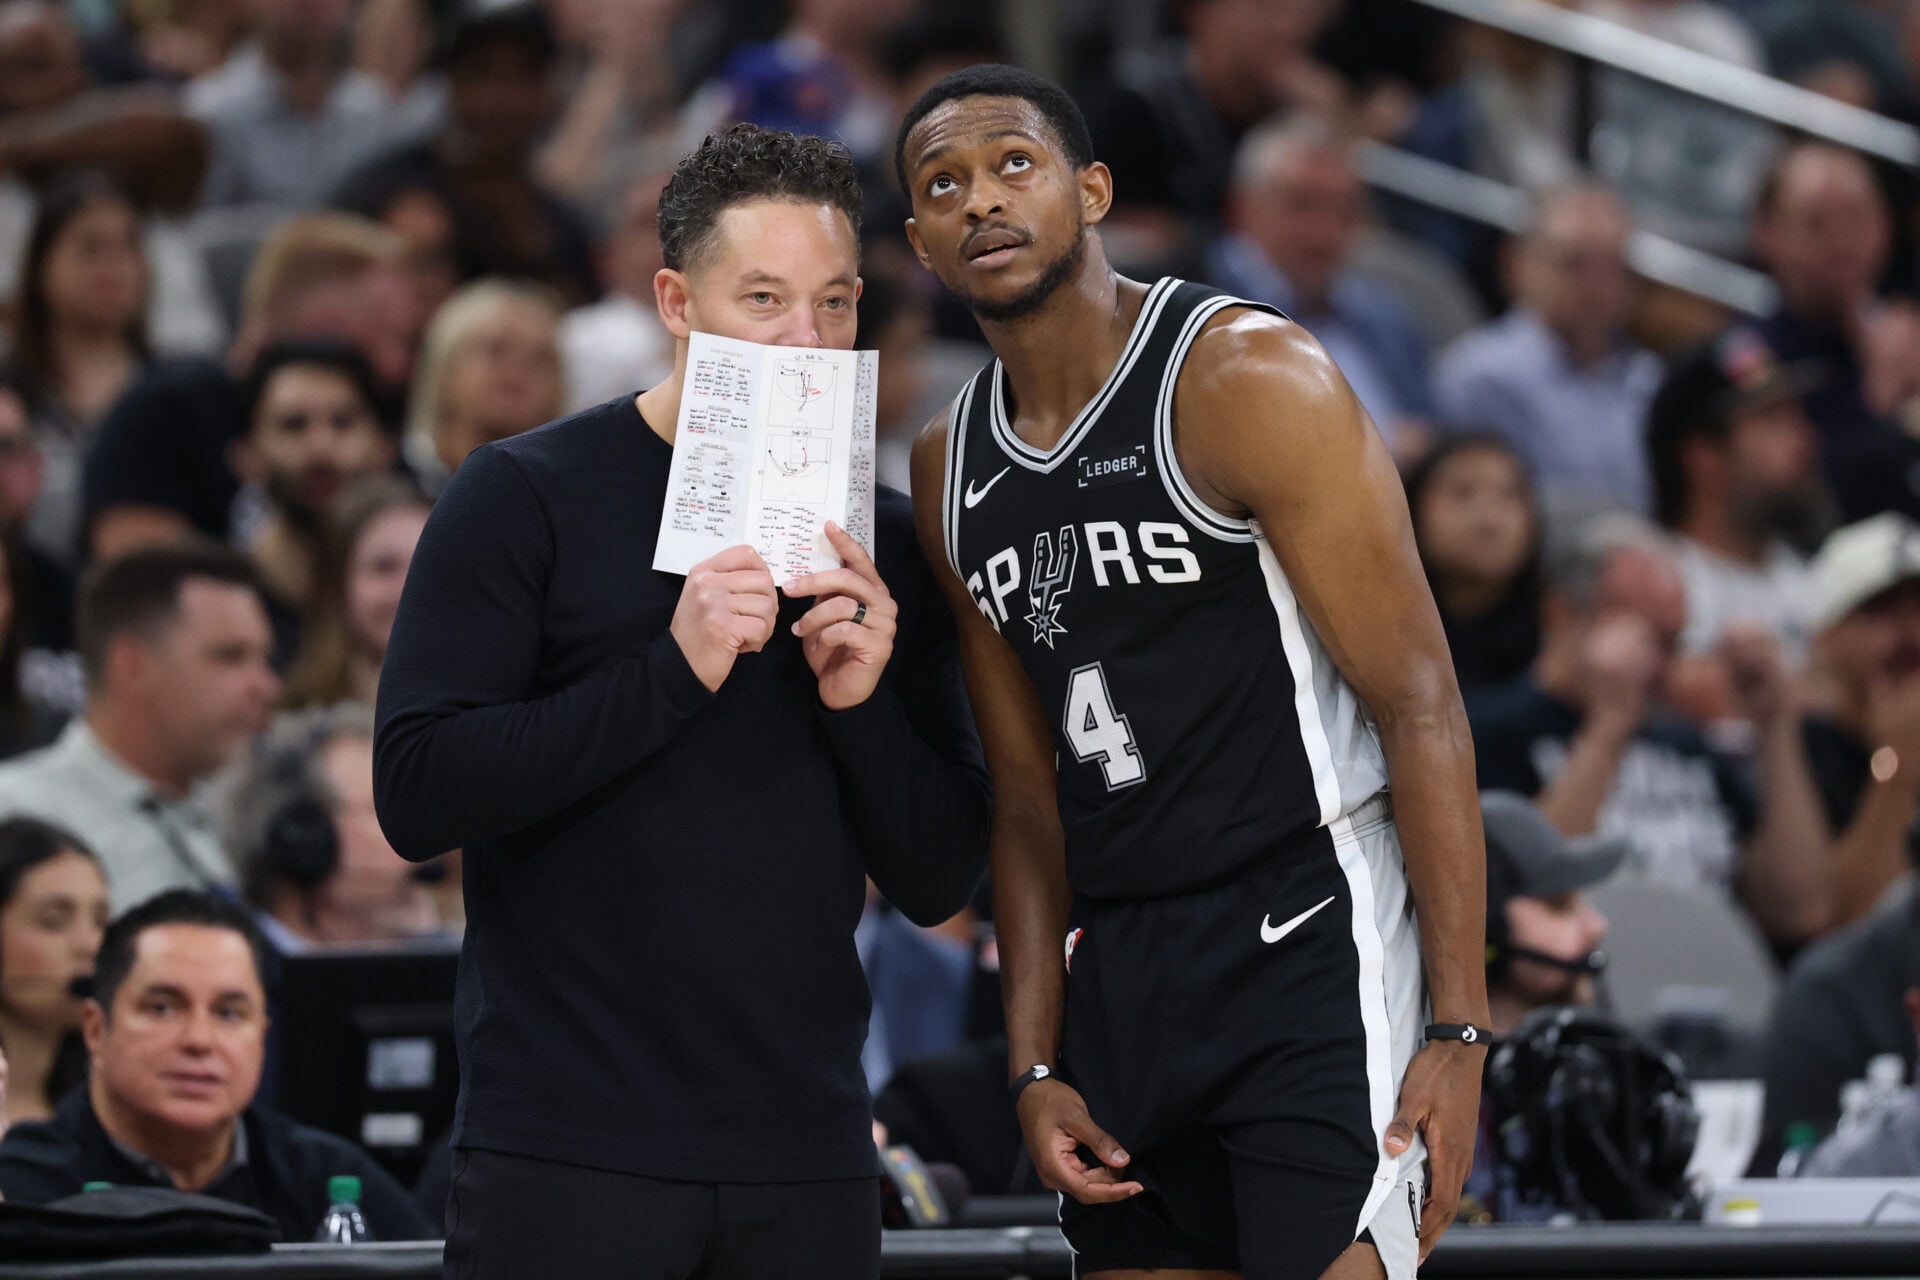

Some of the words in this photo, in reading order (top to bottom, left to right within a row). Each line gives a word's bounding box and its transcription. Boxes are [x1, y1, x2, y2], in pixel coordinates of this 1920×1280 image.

[1086, 455, 1138, 478] LEDGER
[965, 521, 1202, 649] SPURS
[1062, 660, 1147, 792] 4
